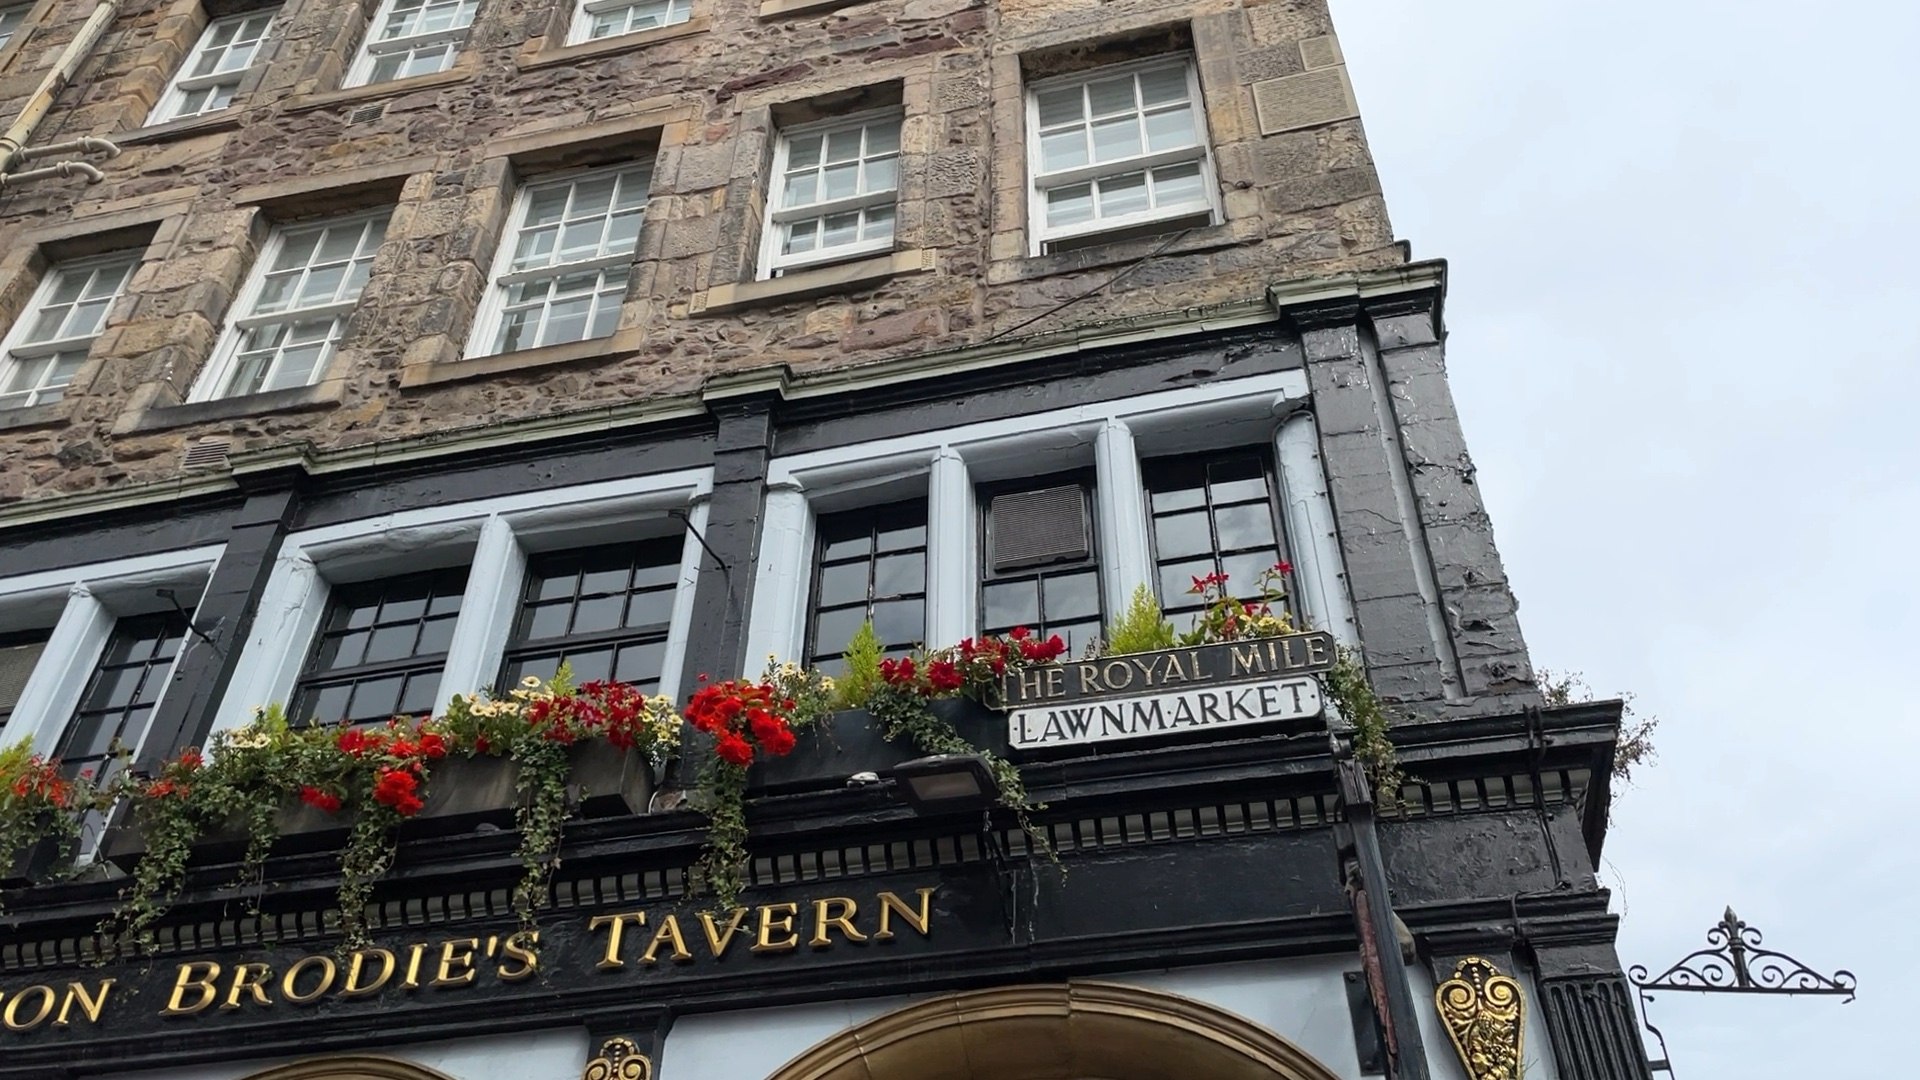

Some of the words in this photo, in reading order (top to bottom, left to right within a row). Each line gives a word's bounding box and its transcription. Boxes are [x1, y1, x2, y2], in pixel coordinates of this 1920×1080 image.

[1079, 652, 1212, 693] ROYAL
[1230, 636, 1328, 676] MILE
[1017, 681, 1308, 744] LAWNMARKET
[0, 978, 117, 1031] ON
[160, 930, 540, 1015] BRODIE'S
[588, 888, 935, 968] TAVERN
